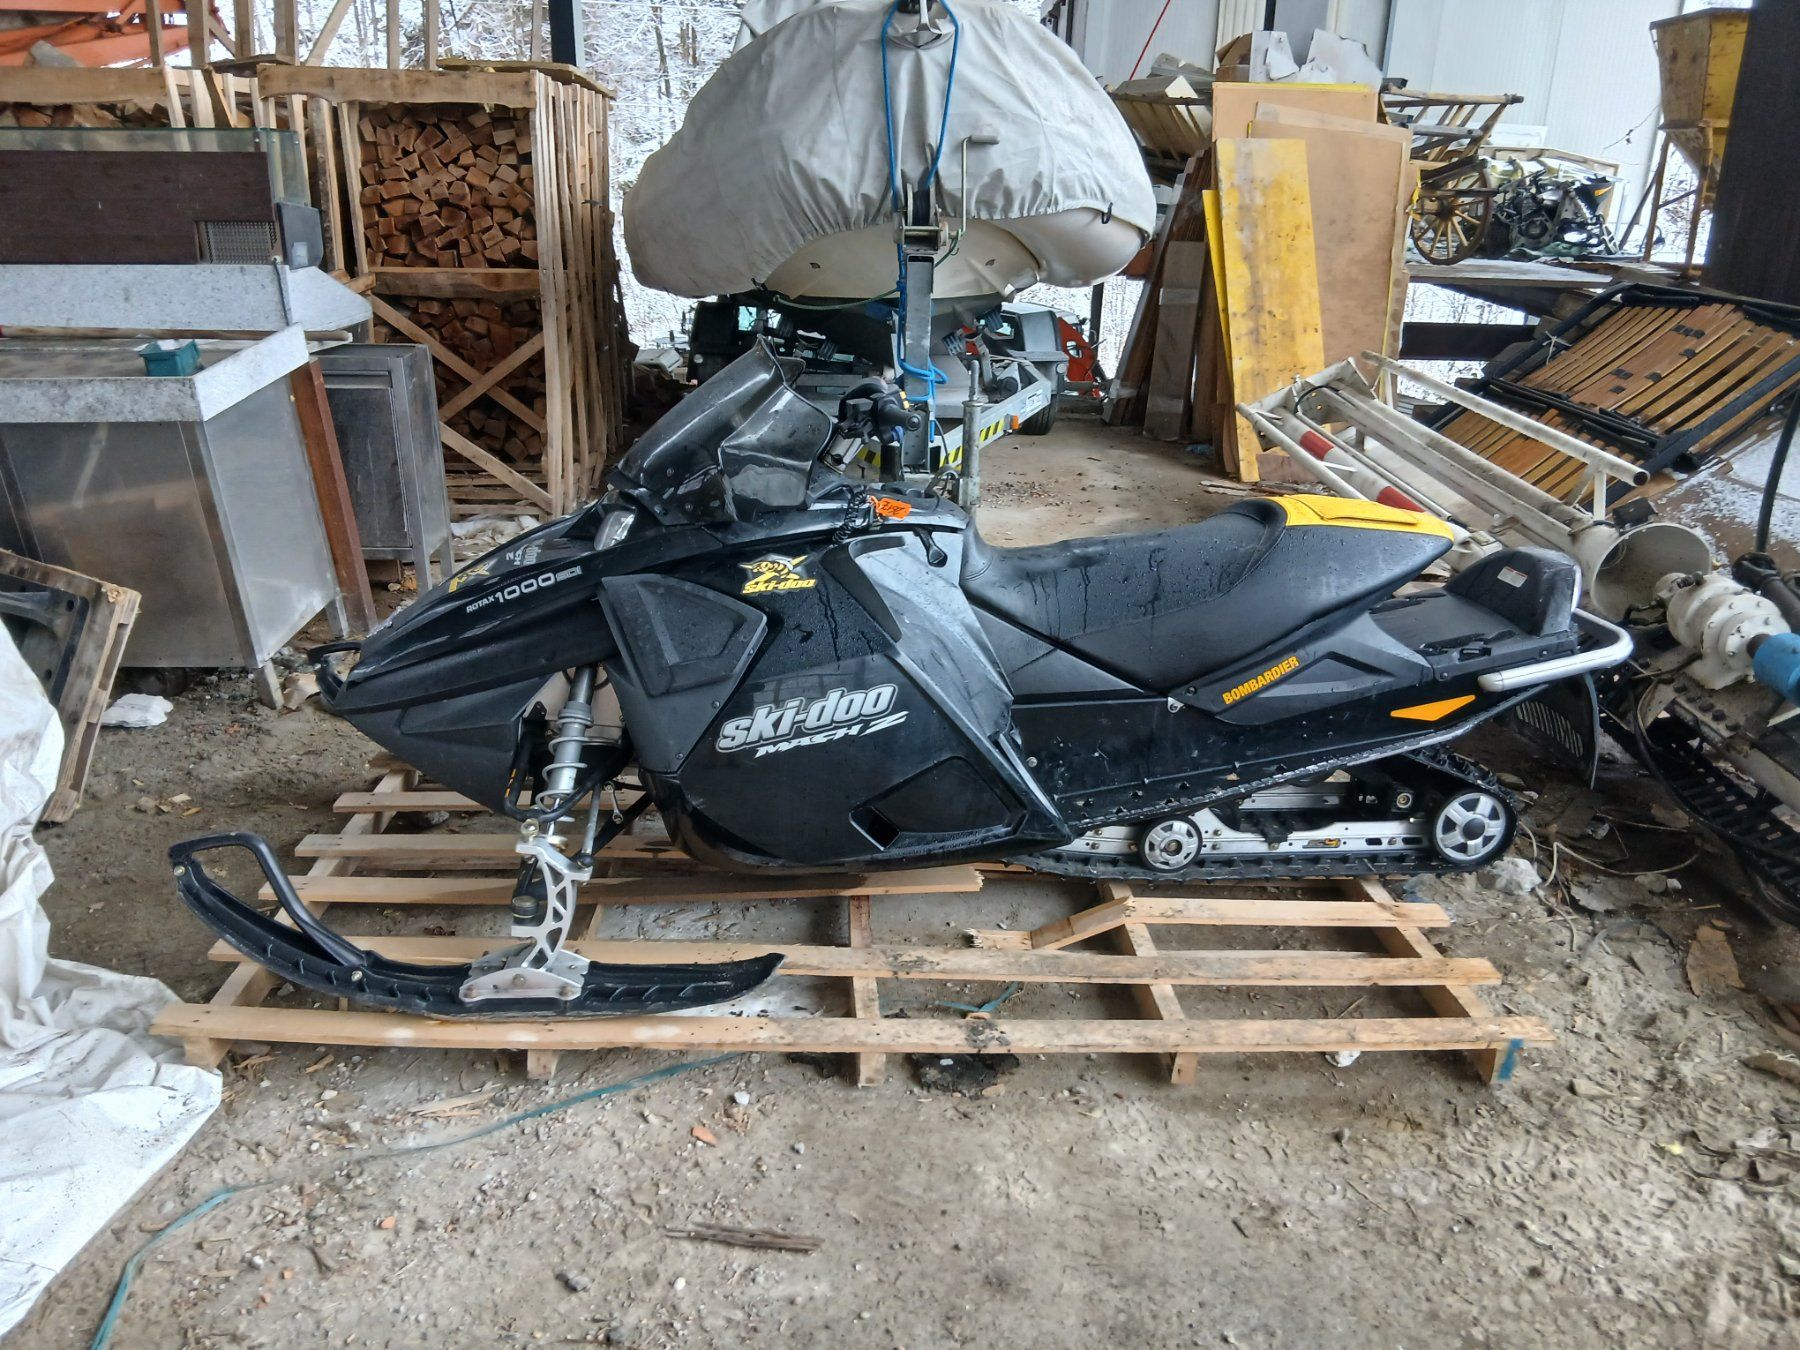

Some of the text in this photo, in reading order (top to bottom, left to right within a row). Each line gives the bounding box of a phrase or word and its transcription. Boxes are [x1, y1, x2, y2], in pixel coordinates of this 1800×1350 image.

[466, 595, 495, 614] ROTAX
[494, 572, 556, 603] 1000
[1222, 656, 1299, 705] BOMBARDIER
[754, 711, 909, 759] MACH Z
